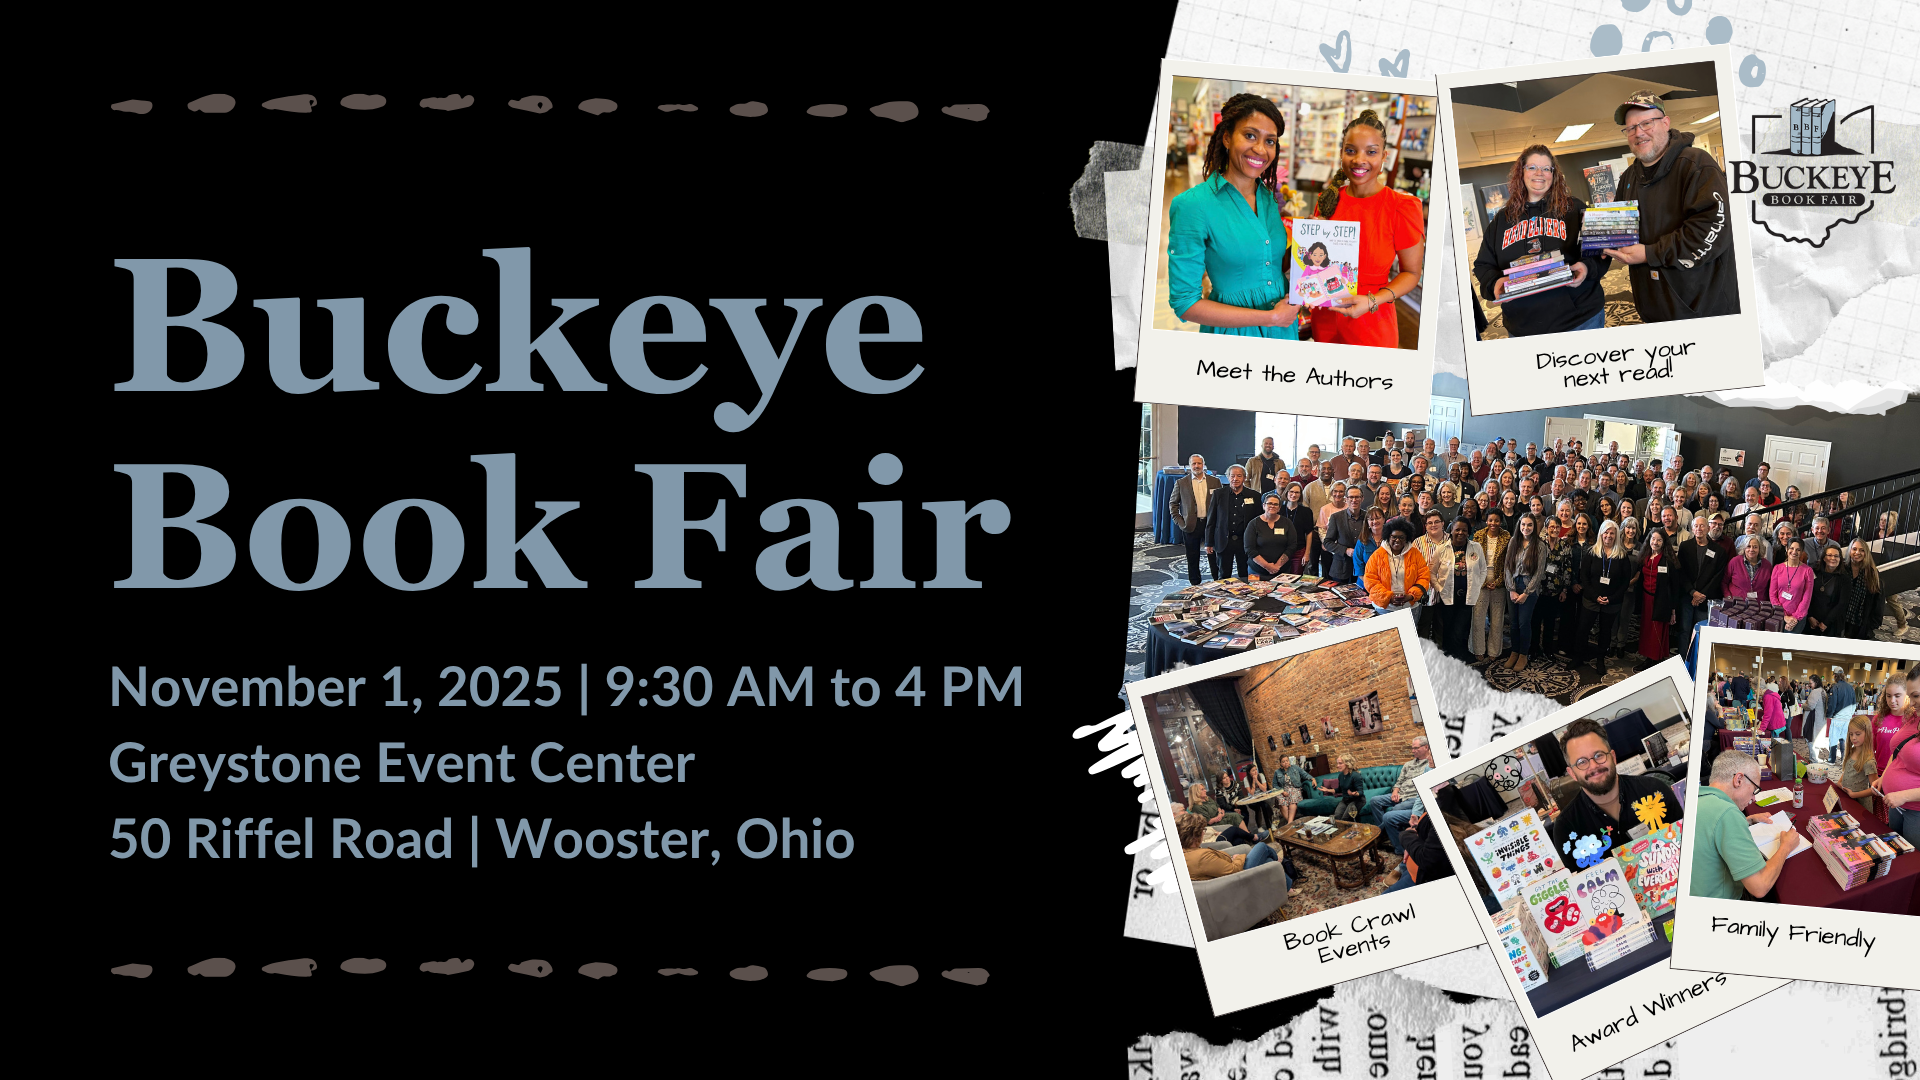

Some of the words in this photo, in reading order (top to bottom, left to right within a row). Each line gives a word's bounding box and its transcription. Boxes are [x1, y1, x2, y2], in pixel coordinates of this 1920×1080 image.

[1300, 223, 1321, 236] STEP
[1322, 228, 1331, 239] by
[1333, 225, 1356, 240] STEP!
[1585, 869, 1604, 880] FEEL
[1577, 869, 1620, 899] CALM
